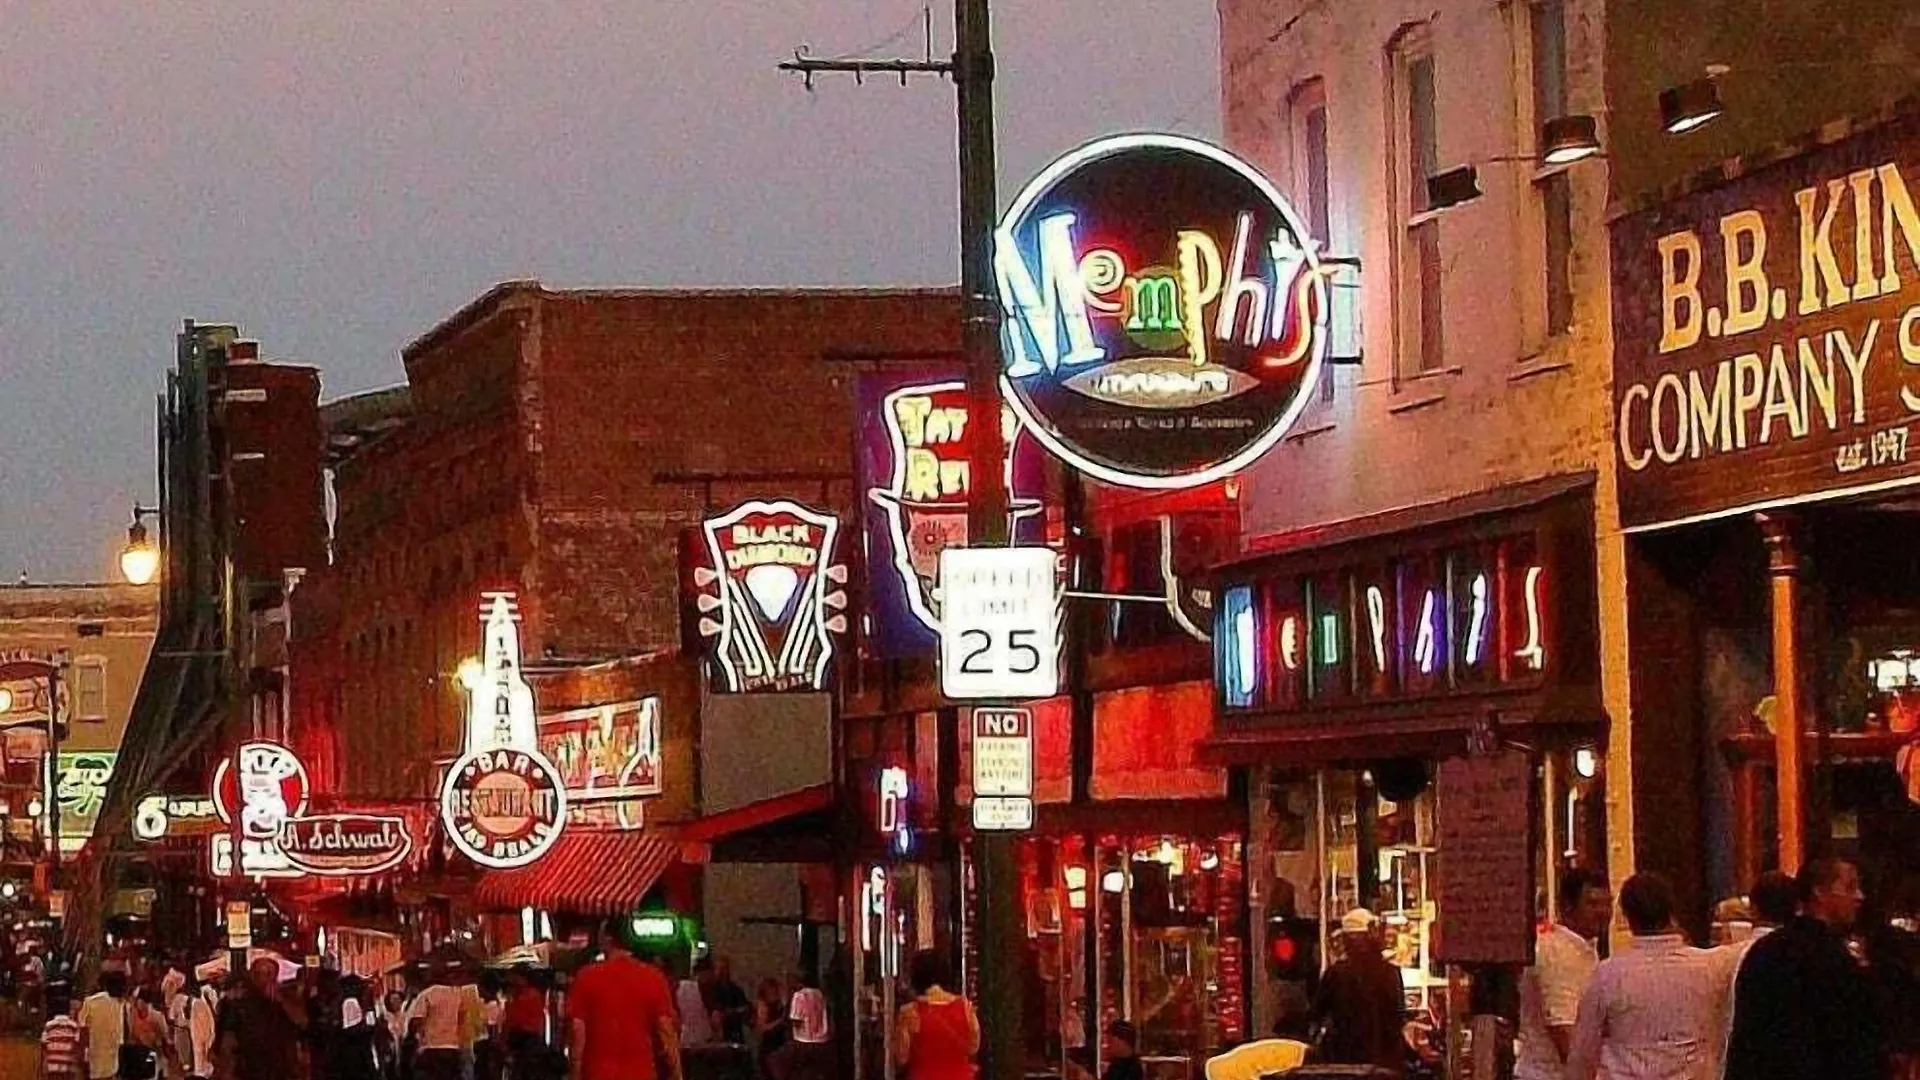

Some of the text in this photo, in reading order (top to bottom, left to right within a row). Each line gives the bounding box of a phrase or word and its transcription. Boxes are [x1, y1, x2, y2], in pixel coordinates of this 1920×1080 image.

[1657, 209, 1787, 354] B.B.
[1619, 319, 1880, 471] COMPANY
[732, 524, 810, 544] BLACK
[960, 628, 1040, 674] 25
[984, 713, 1019, 735] NO
[477, 751, 530, 775] BAR
[308, 820, 398, 851] Schwab
